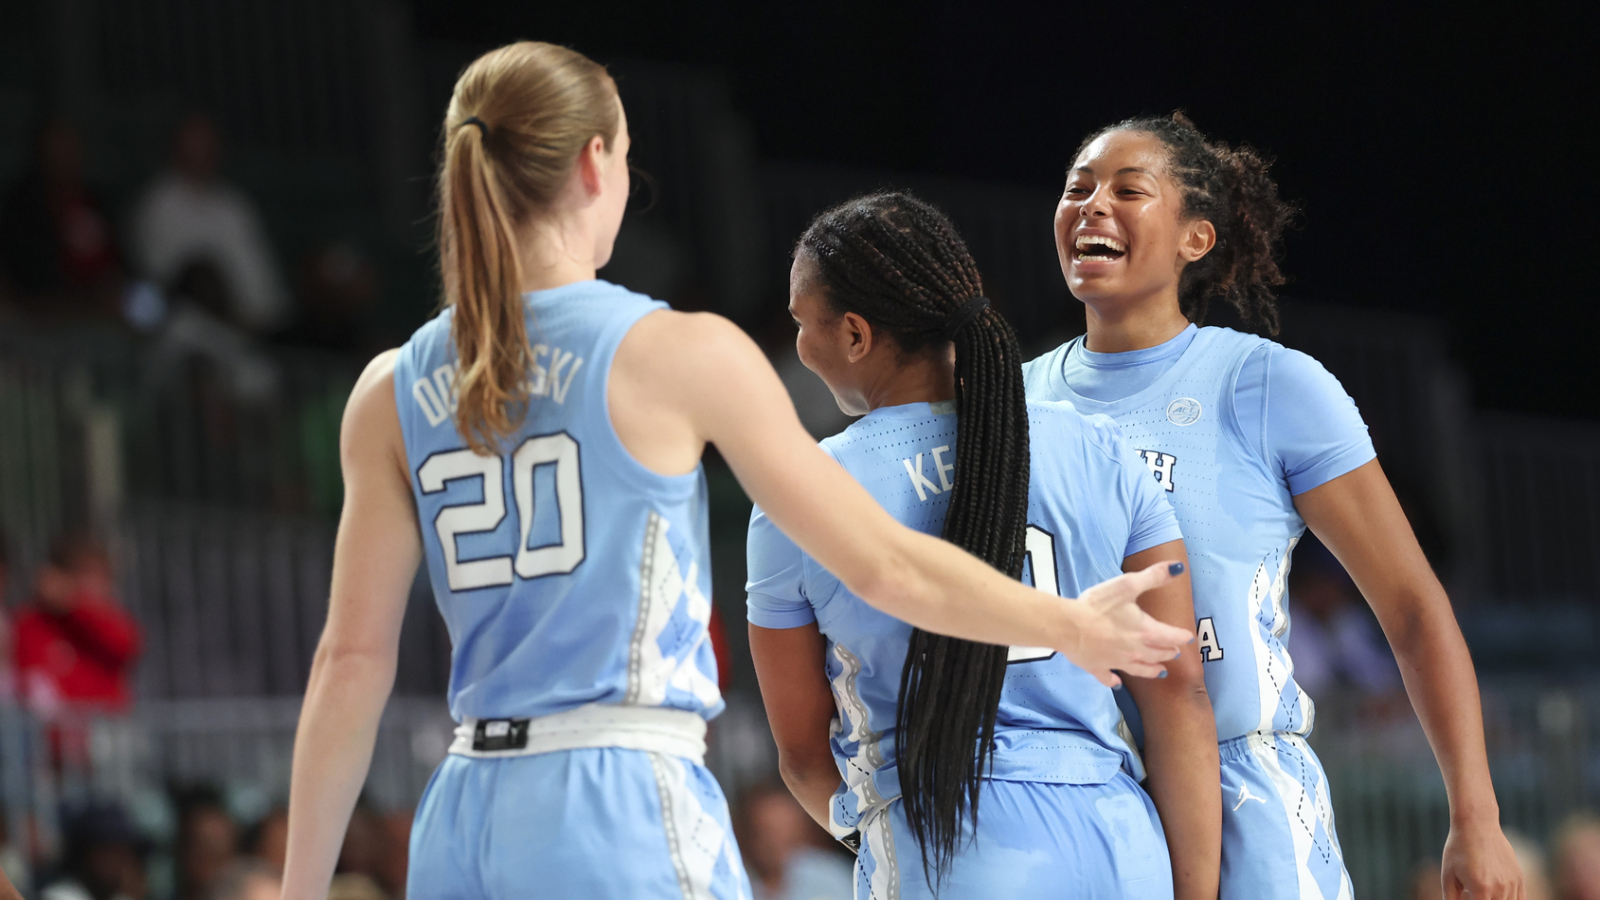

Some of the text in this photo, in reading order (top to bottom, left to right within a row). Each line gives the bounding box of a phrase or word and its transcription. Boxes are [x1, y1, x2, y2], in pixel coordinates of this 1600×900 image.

[413, 344, 584, 427] DOSKI
[417, 431, 586, 592] 20
[903, 445, 955, 501] KE
